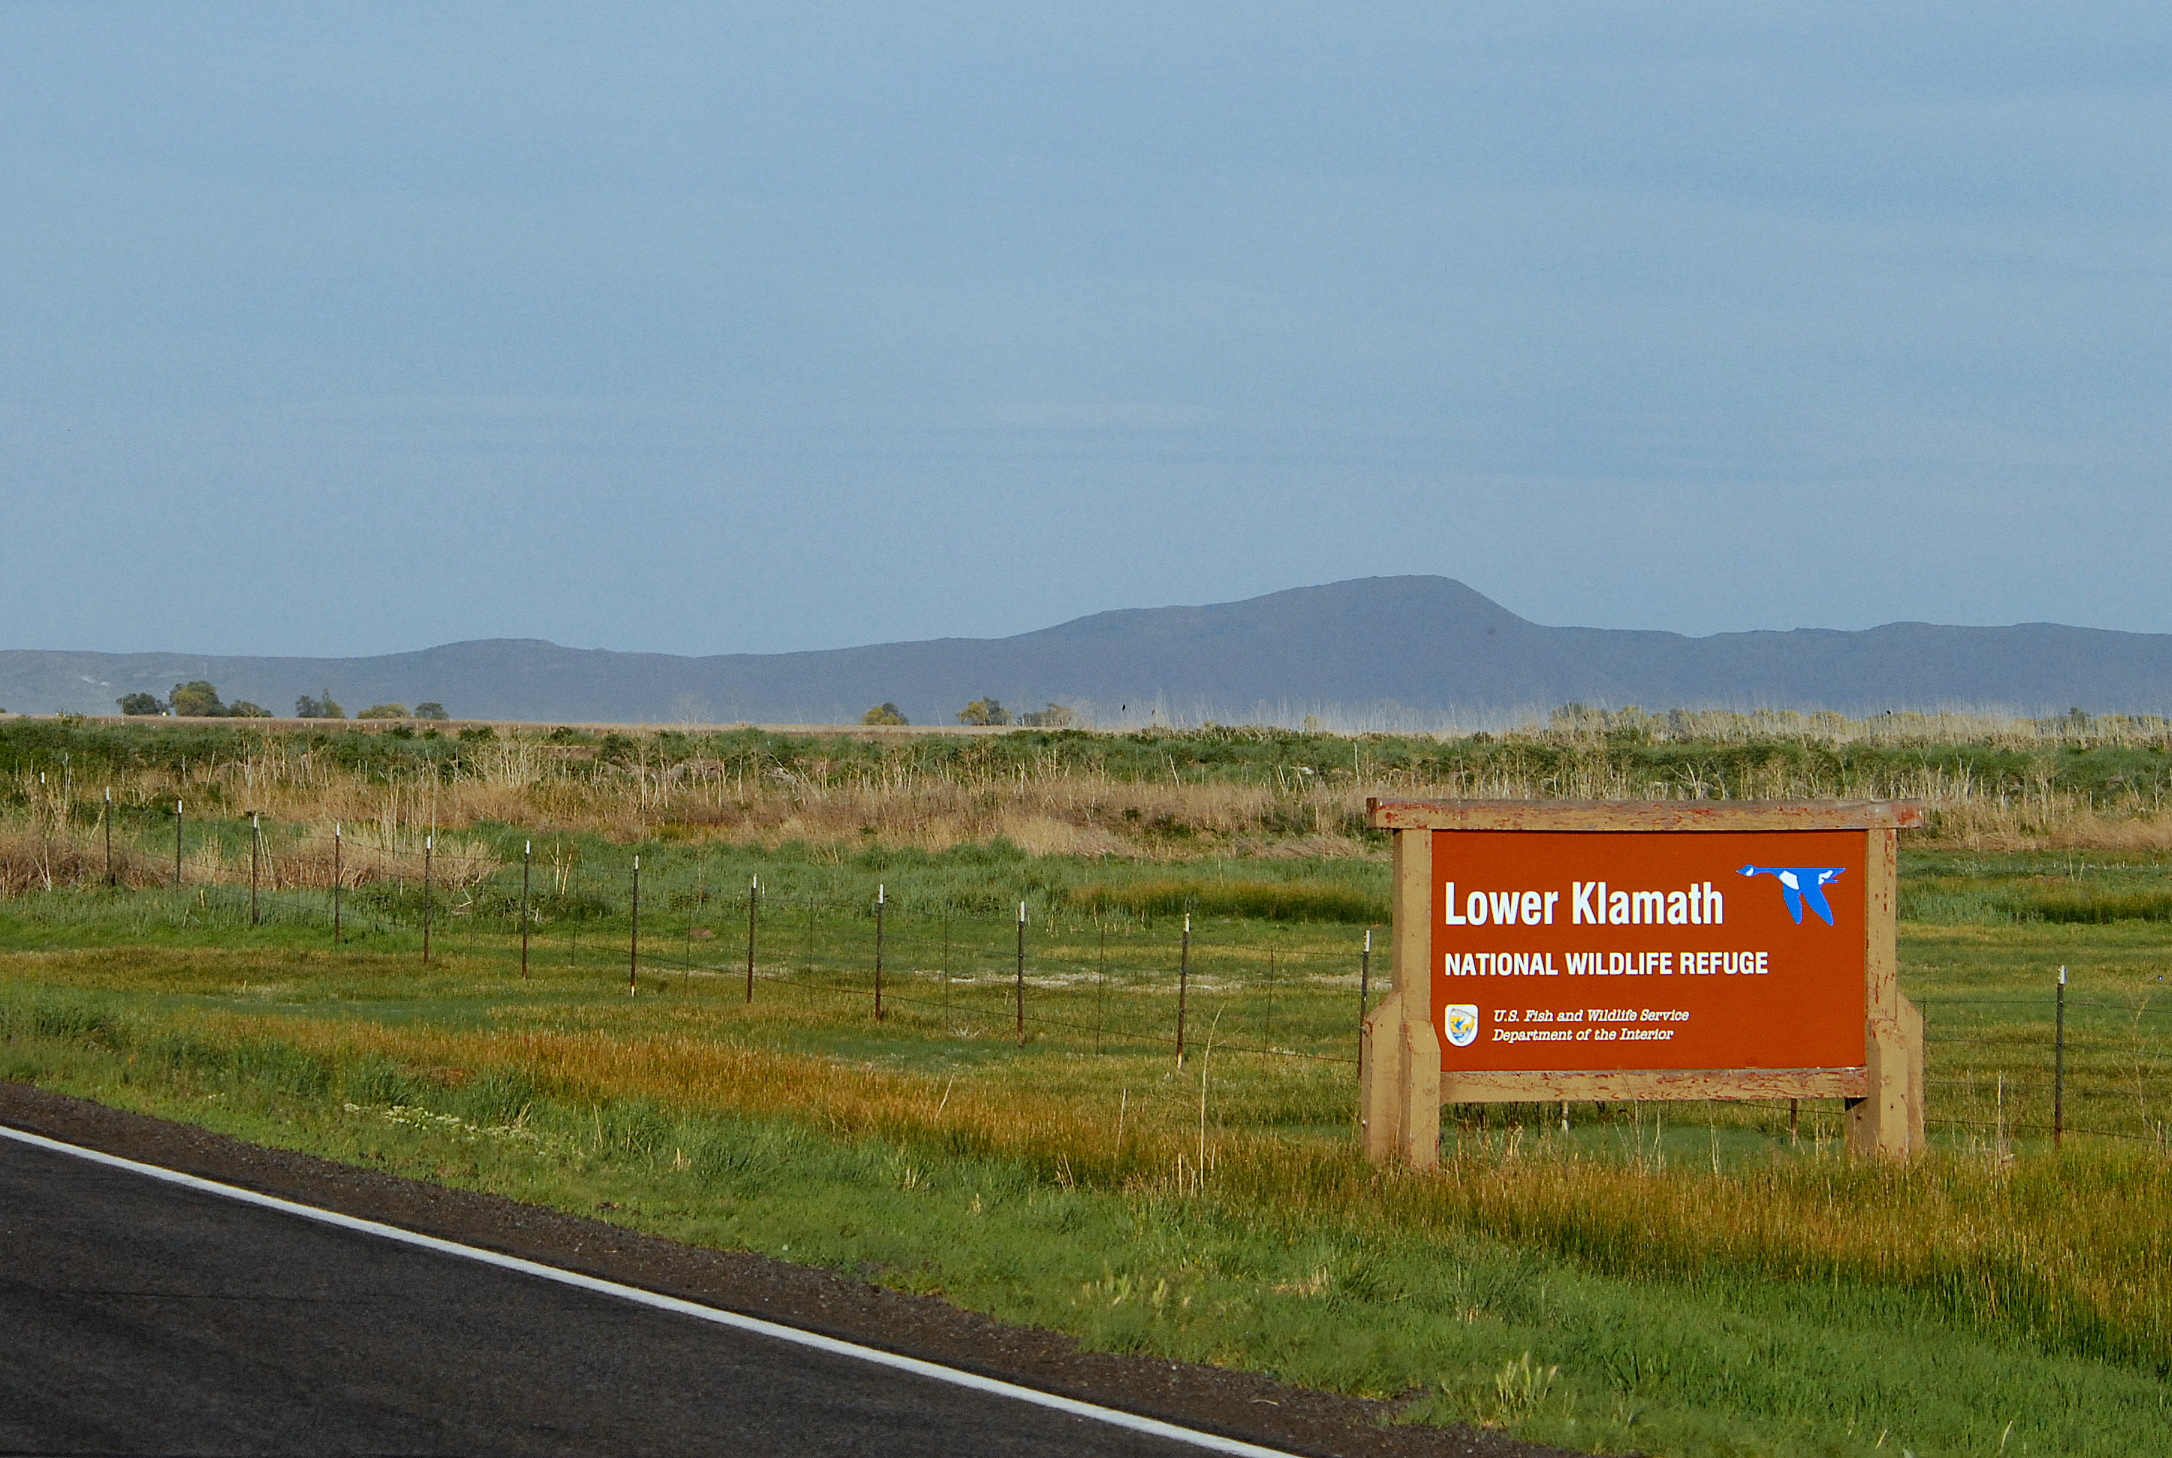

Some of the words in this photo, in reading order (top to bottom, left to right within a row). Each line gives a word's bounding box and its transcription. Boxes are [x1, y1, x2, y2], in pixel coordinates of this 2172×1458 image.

[1445, 881, 1560, 926] Lower
[1572, 881, 1724, 926] Klamath
[1445, 952, 1559, 977] NATIONAL
[1565, 952, 1673, 976] WILDLIFE
[1680, 951, 1769, 975] REFUGE
[1493, 1009, 1520, 1022] U.S.
[1523, 1009, 1554, 1022] Fish
[1557, 1009, 1584, 1022] and
[1587, 1009, 1637, 1022] Wildlife
[1640, 1008, 1690, 1021] Service
[1492, 1028, 1573, 1044] Department
[1576, 1028, 1592, 1041] of
[1594, 1028, 1617, 1041] the
[1619, 1028, 1675, 1041] Interior
